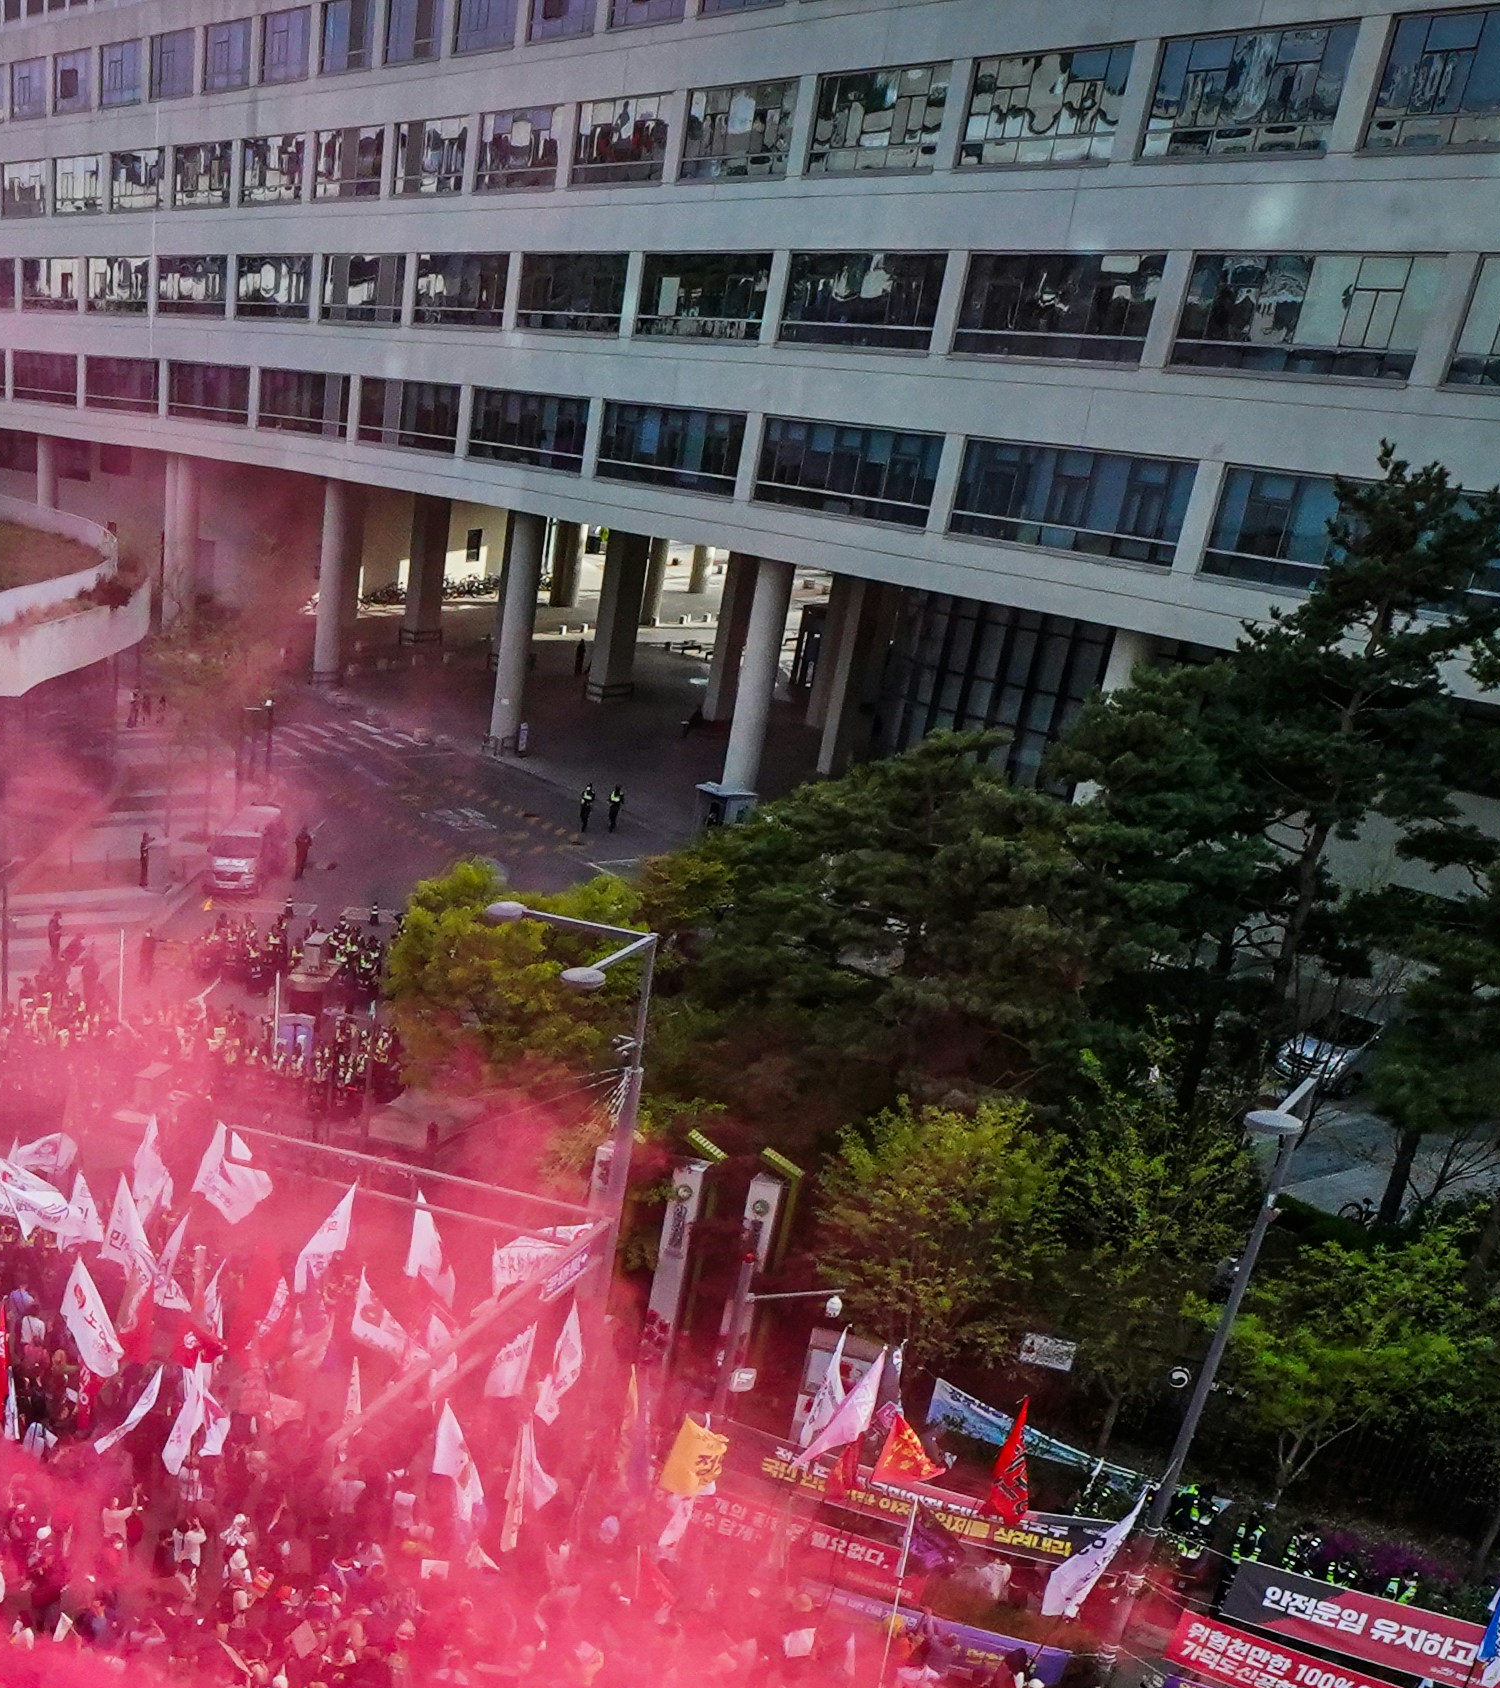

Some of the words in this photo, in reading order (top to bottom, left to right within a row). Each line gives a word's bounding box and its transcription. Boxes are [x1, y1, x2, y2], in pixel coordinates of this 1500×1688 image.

[810, 1533, 891, 1570] 필요없다.
[992, 1528, 1073, 1556] 살려내라
[1188, 1622, 1291, 1673] 위험천만한
[1261, 1586, 1370, 1638] 안전운임
[1372, 1615, 1478, 1669] 유지하고
